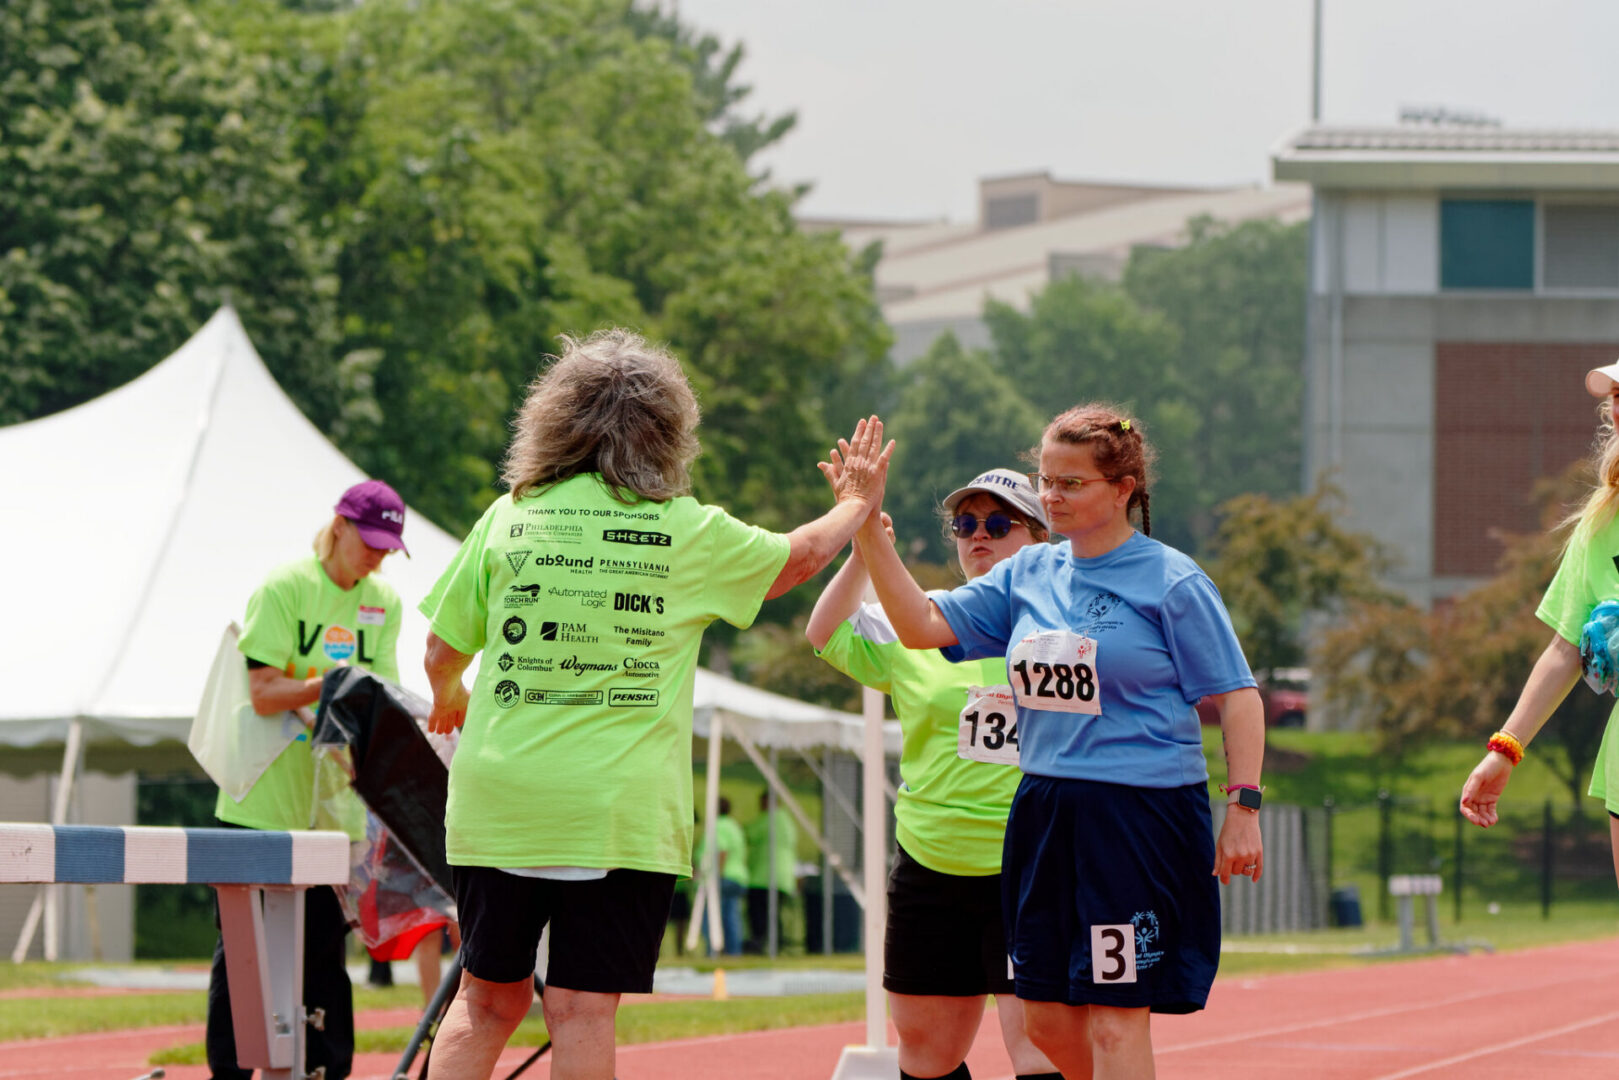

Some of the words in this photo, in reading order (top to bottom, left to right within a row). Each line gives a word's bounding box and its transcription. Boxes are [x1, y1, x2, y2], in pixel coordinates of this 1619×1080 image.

[558, 508, 577, 516] YOU
[613, 510, 660, 521] SPONSORS
[606, 531, 668, 545] SHEETZ
[535, 554, 594, 568] abound
[600, 559, 670, 573] PENNSYLVANIA
[551, 586, 607, 599] Automated
[581, 597, 606, 609] Logic
[614, 592, 664, 615] DICK'S
[561, 622, 587, 632] PAM
[614, 625, 629, 634] The
[631, 627, 665, 637] Misitano
[626, 637, 652, 647] Family
[517, 656, 544, 666] Knights
[558, 654, 618, 677] Wegmans
[623, 657, 660, 669] Ciocca
[517, 664, 553, 672] Columbus
[1013, 659, 1096, 702] 1288
[612, 693, 656, 701] PENSKE
[1101, 928, 1127, 981] 3
